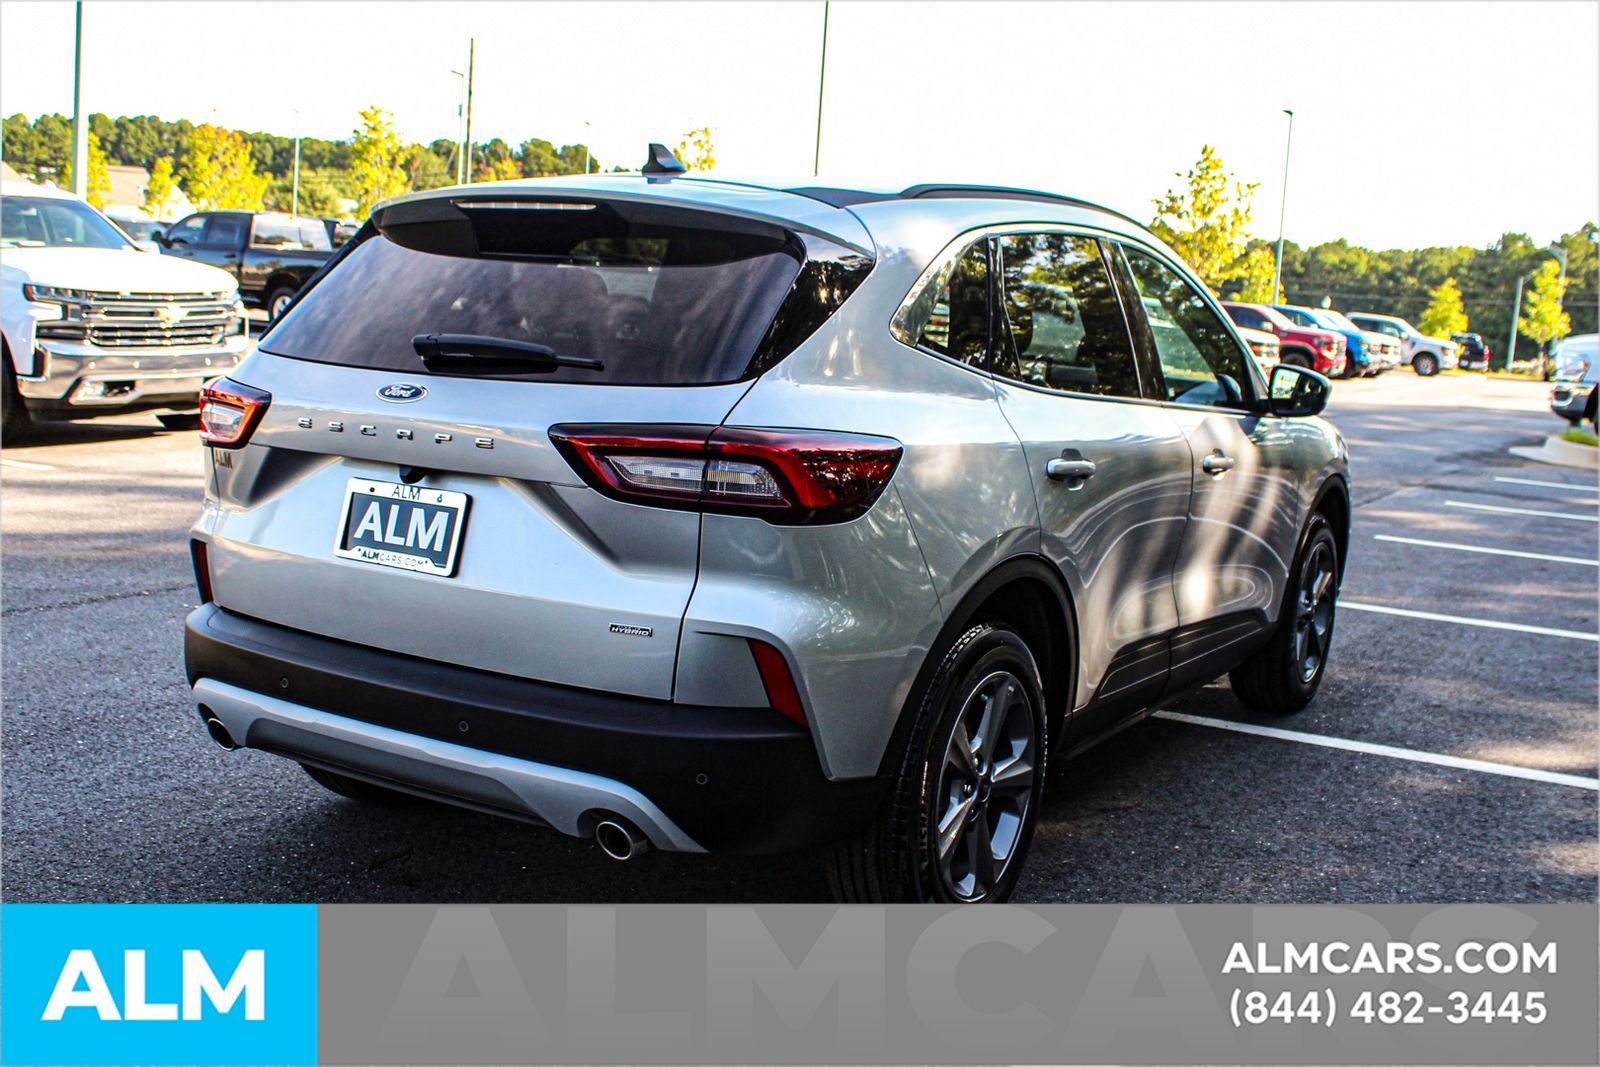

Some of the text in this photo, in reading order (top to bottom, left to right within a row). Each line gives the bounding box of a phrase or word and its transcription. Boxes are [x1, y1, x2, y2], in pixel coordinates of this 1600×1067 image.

[384, 384, 416, 398] Ford
[298, 417, 494, 449] ESCAPE
[391, 485, 420, 501] ALM
[353, 501, 450, 552] ALM
[611, 626, 650, 636] HYBRID
